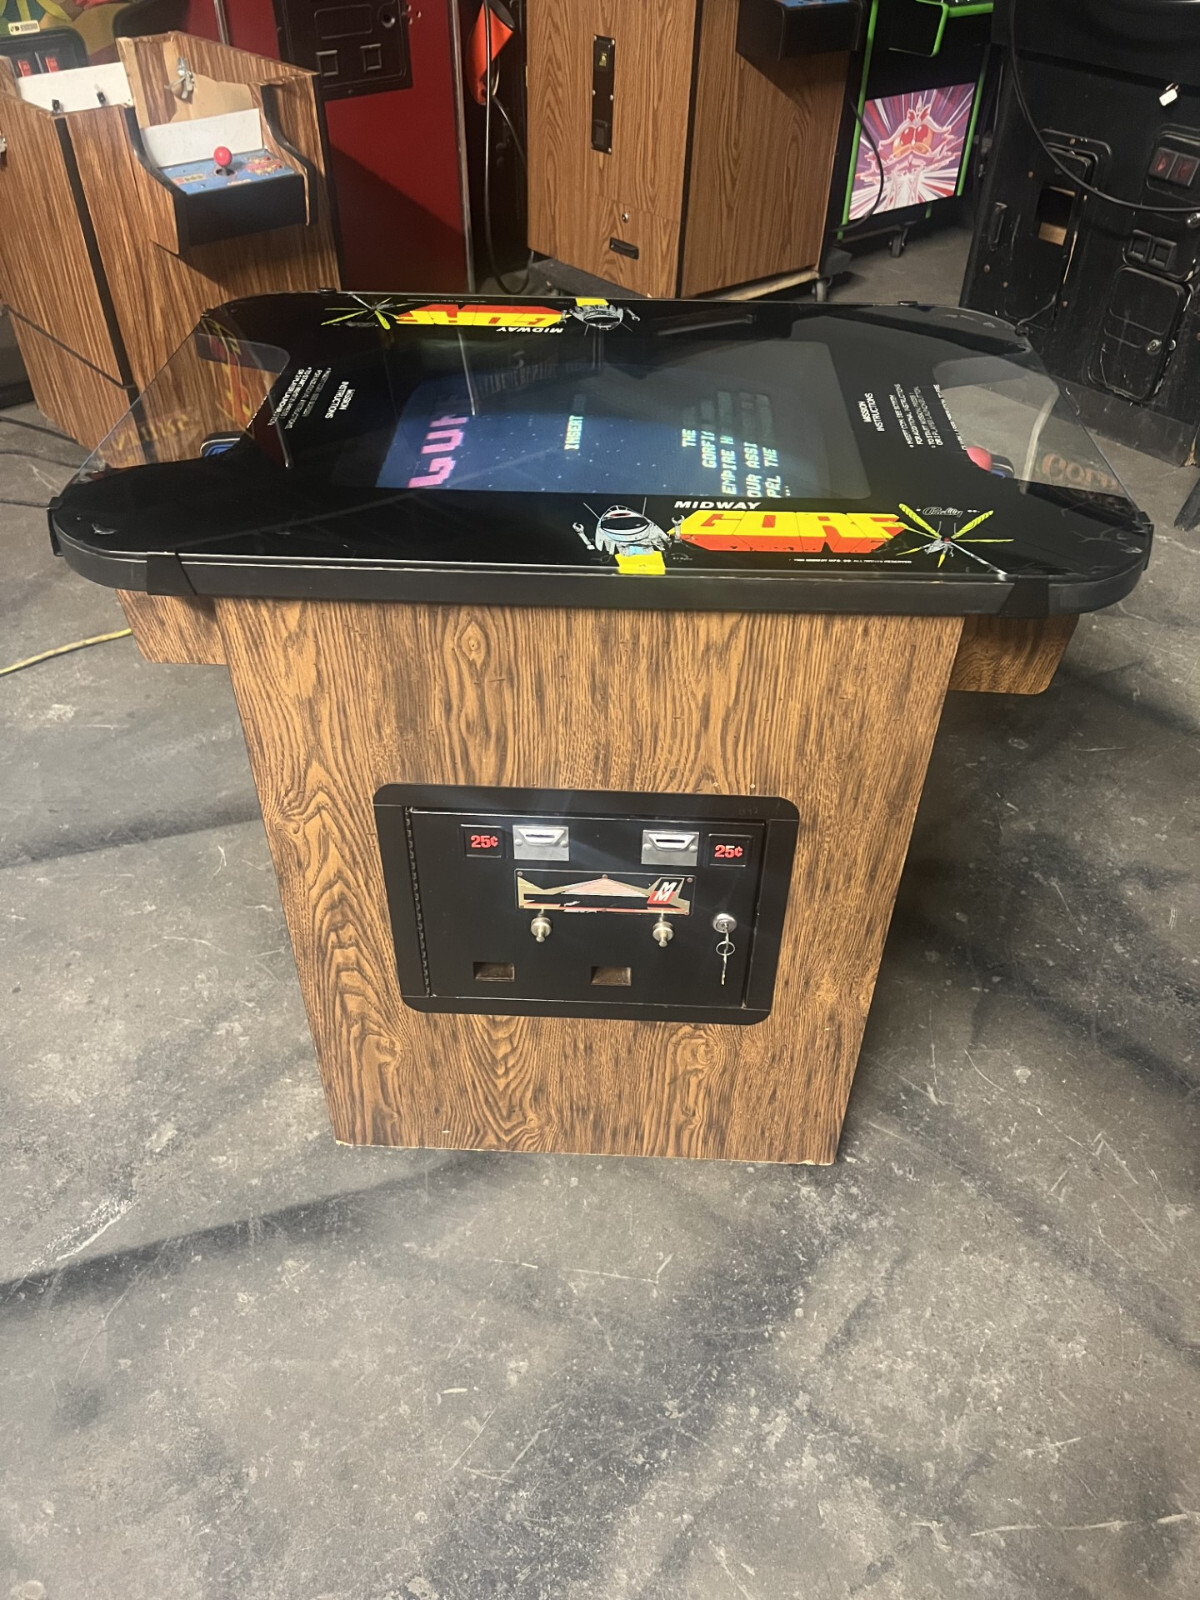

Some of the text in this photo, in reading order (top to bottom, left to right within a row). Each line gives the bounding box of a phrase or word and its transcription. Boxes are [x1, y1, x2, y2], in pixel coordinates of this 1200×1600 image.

[495, 326, 564, 334] MIDWAY
[864, 392, 885, 432] INSTRUCTIONS
[564, 415, 584, 450] INSERT
[681, 428, 697, 448] THE
[762, 447, 779, 468] THE
[721, 448, 738, 495] EMPIRE
[674, 500, 762, 510] MIDWAY
[669, 510, 905, 553] GORF
[470, 834, 498, 849] 25¢
[714, 844, 743, 859] 25¢
